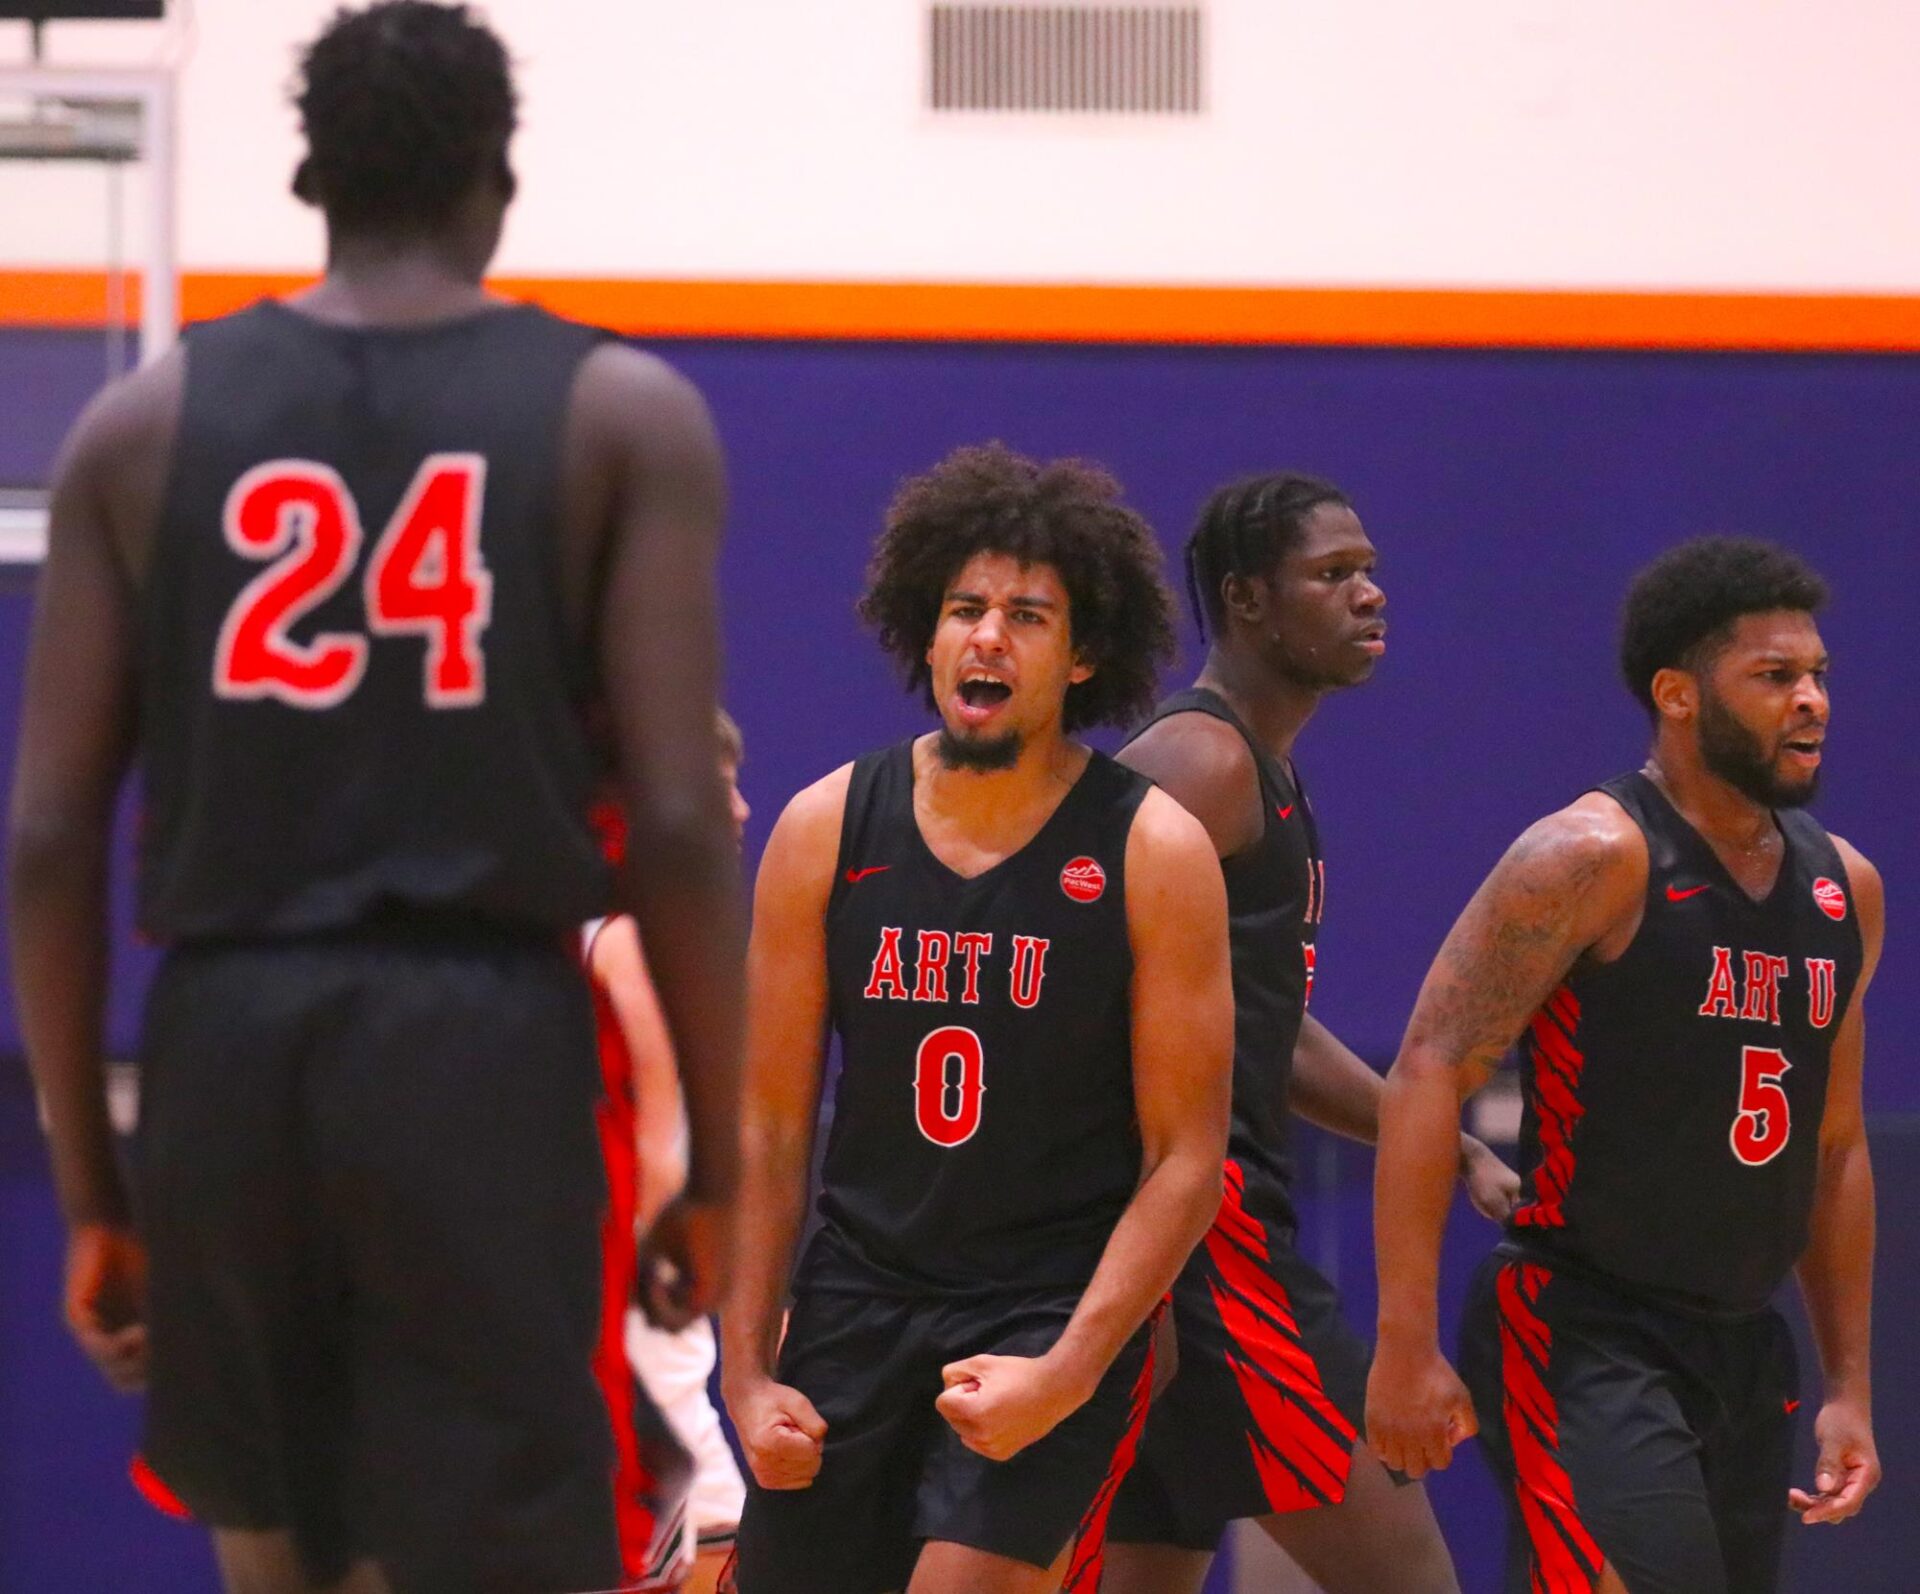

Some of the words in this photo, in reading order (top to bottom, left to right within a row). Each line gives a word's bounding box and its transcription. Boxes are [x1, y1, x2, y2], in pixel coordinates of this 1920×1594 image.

[212, 452, 493, 710] 24
[864, 926, 993, 1004] ART
[1009, 934, 1050, 1009] U
[1698, 946, 1789, 1026] ART
[1805, 957, 1837, 1029] U
[912, 1025, 987, 1147] 0
[1729, 1045, 1793, 1166] 5
